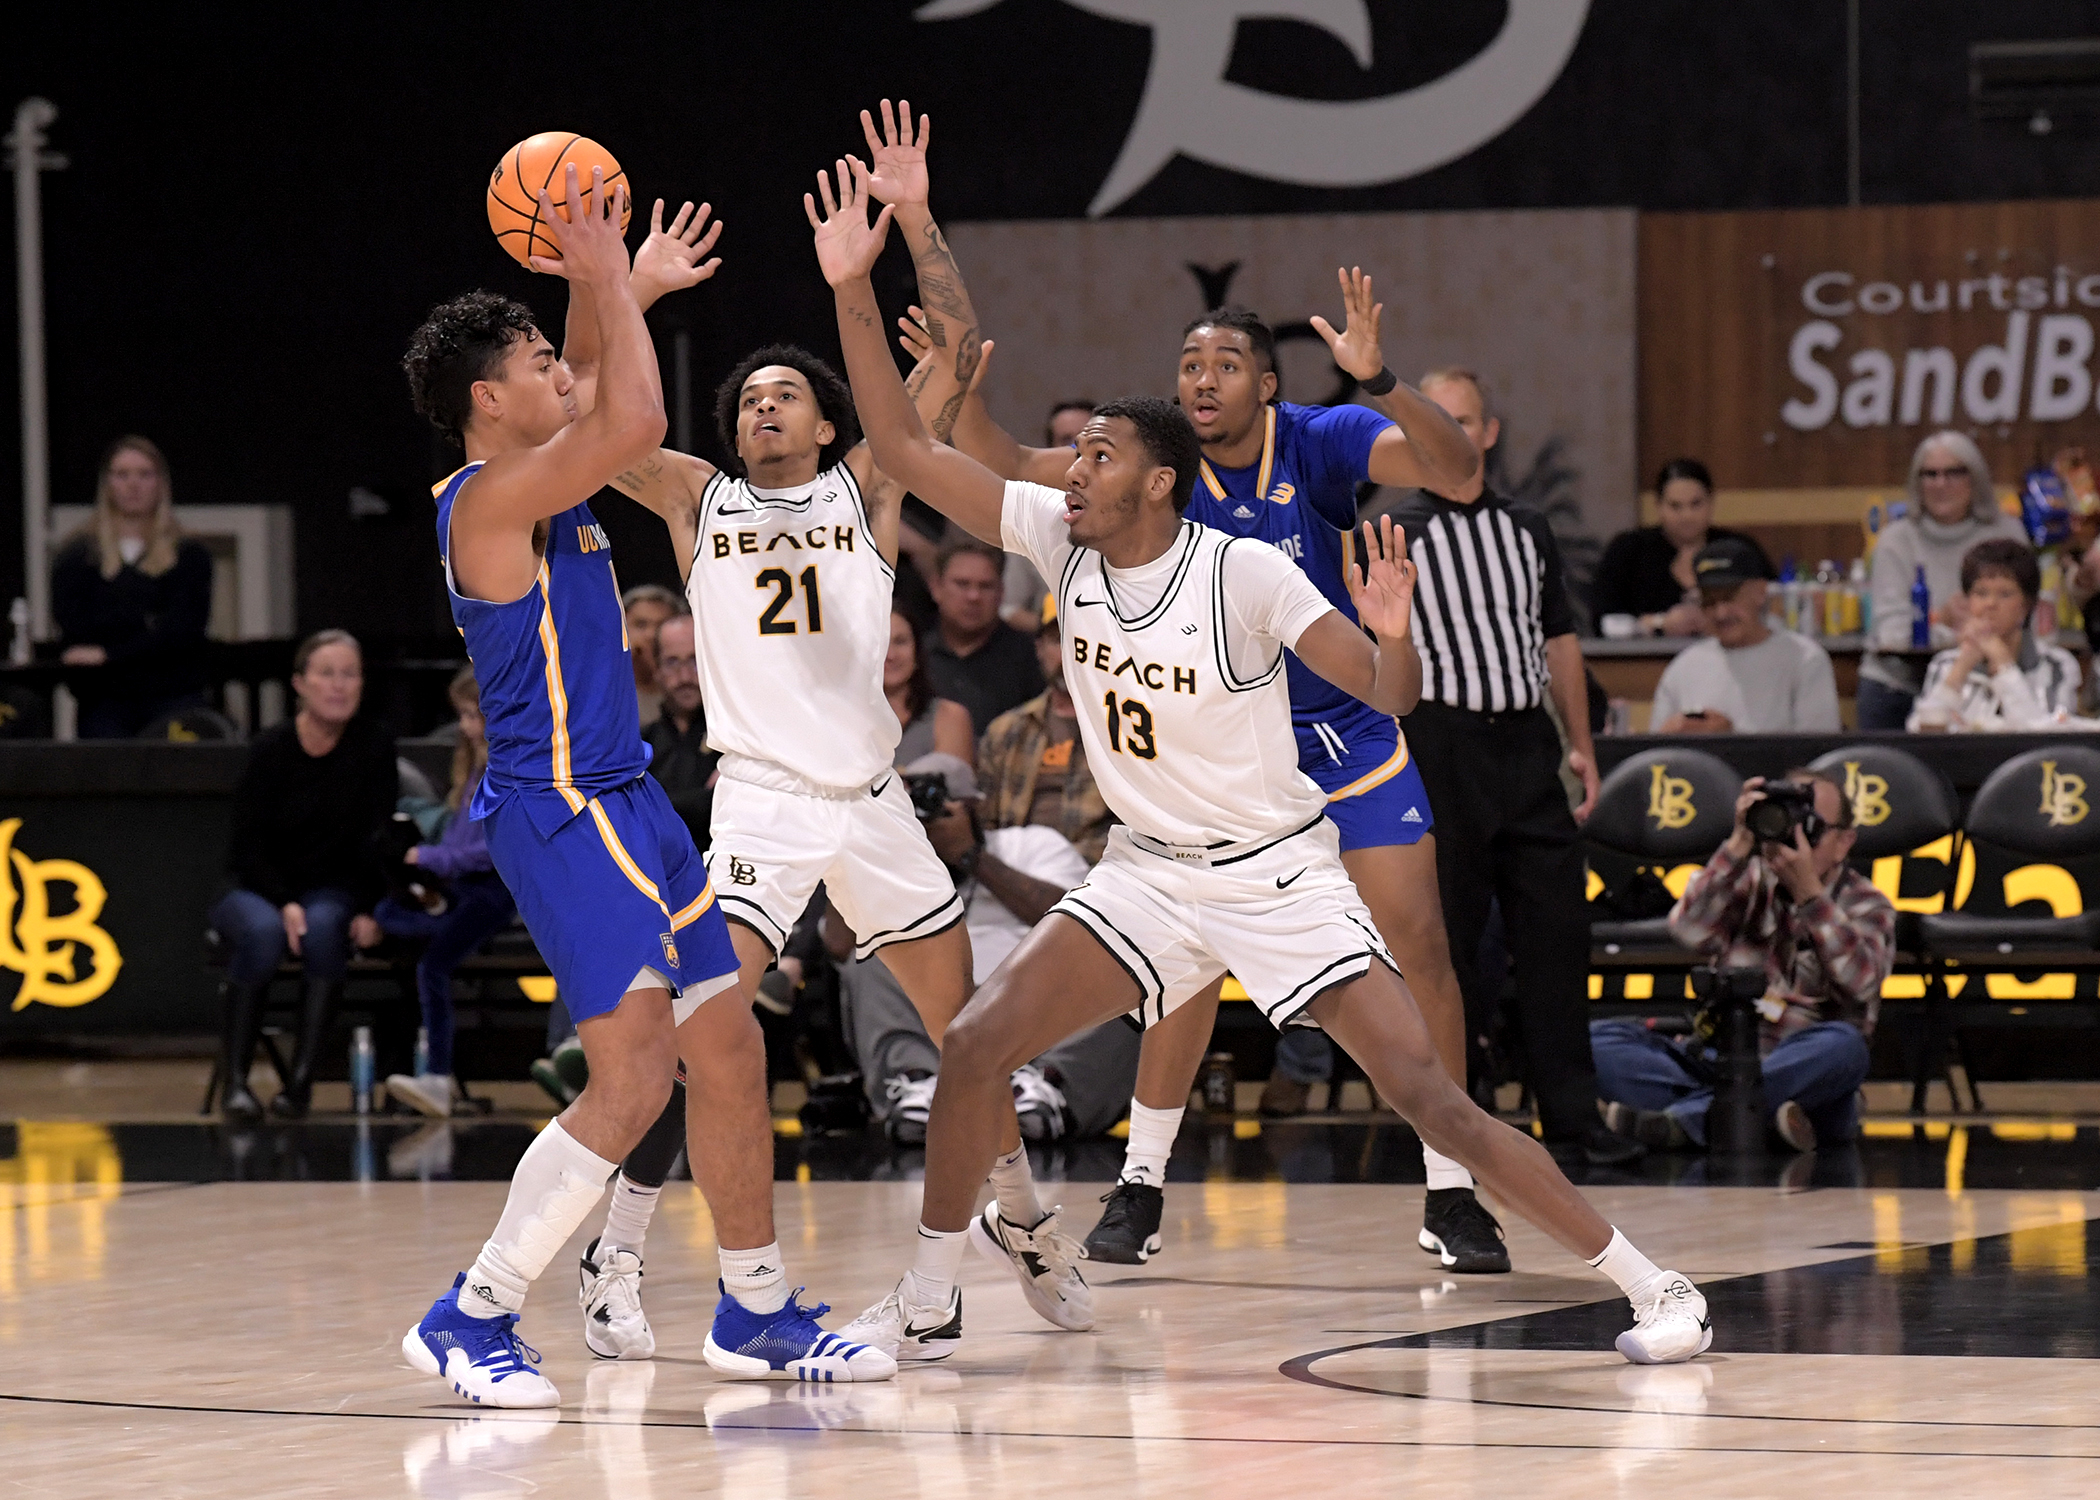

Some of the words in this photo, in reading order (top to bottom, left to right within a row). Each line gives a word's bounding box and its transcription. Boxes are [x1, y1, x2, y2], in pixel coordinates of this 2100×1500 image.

[1780, 309, 2100, 431] SandB
[712, 525, 855, 559] BEACH
[754, 563, 824, 637] 21
[1073, 636, 1197, 695] BEACH
[1102, 688, 1159, 762] 13
